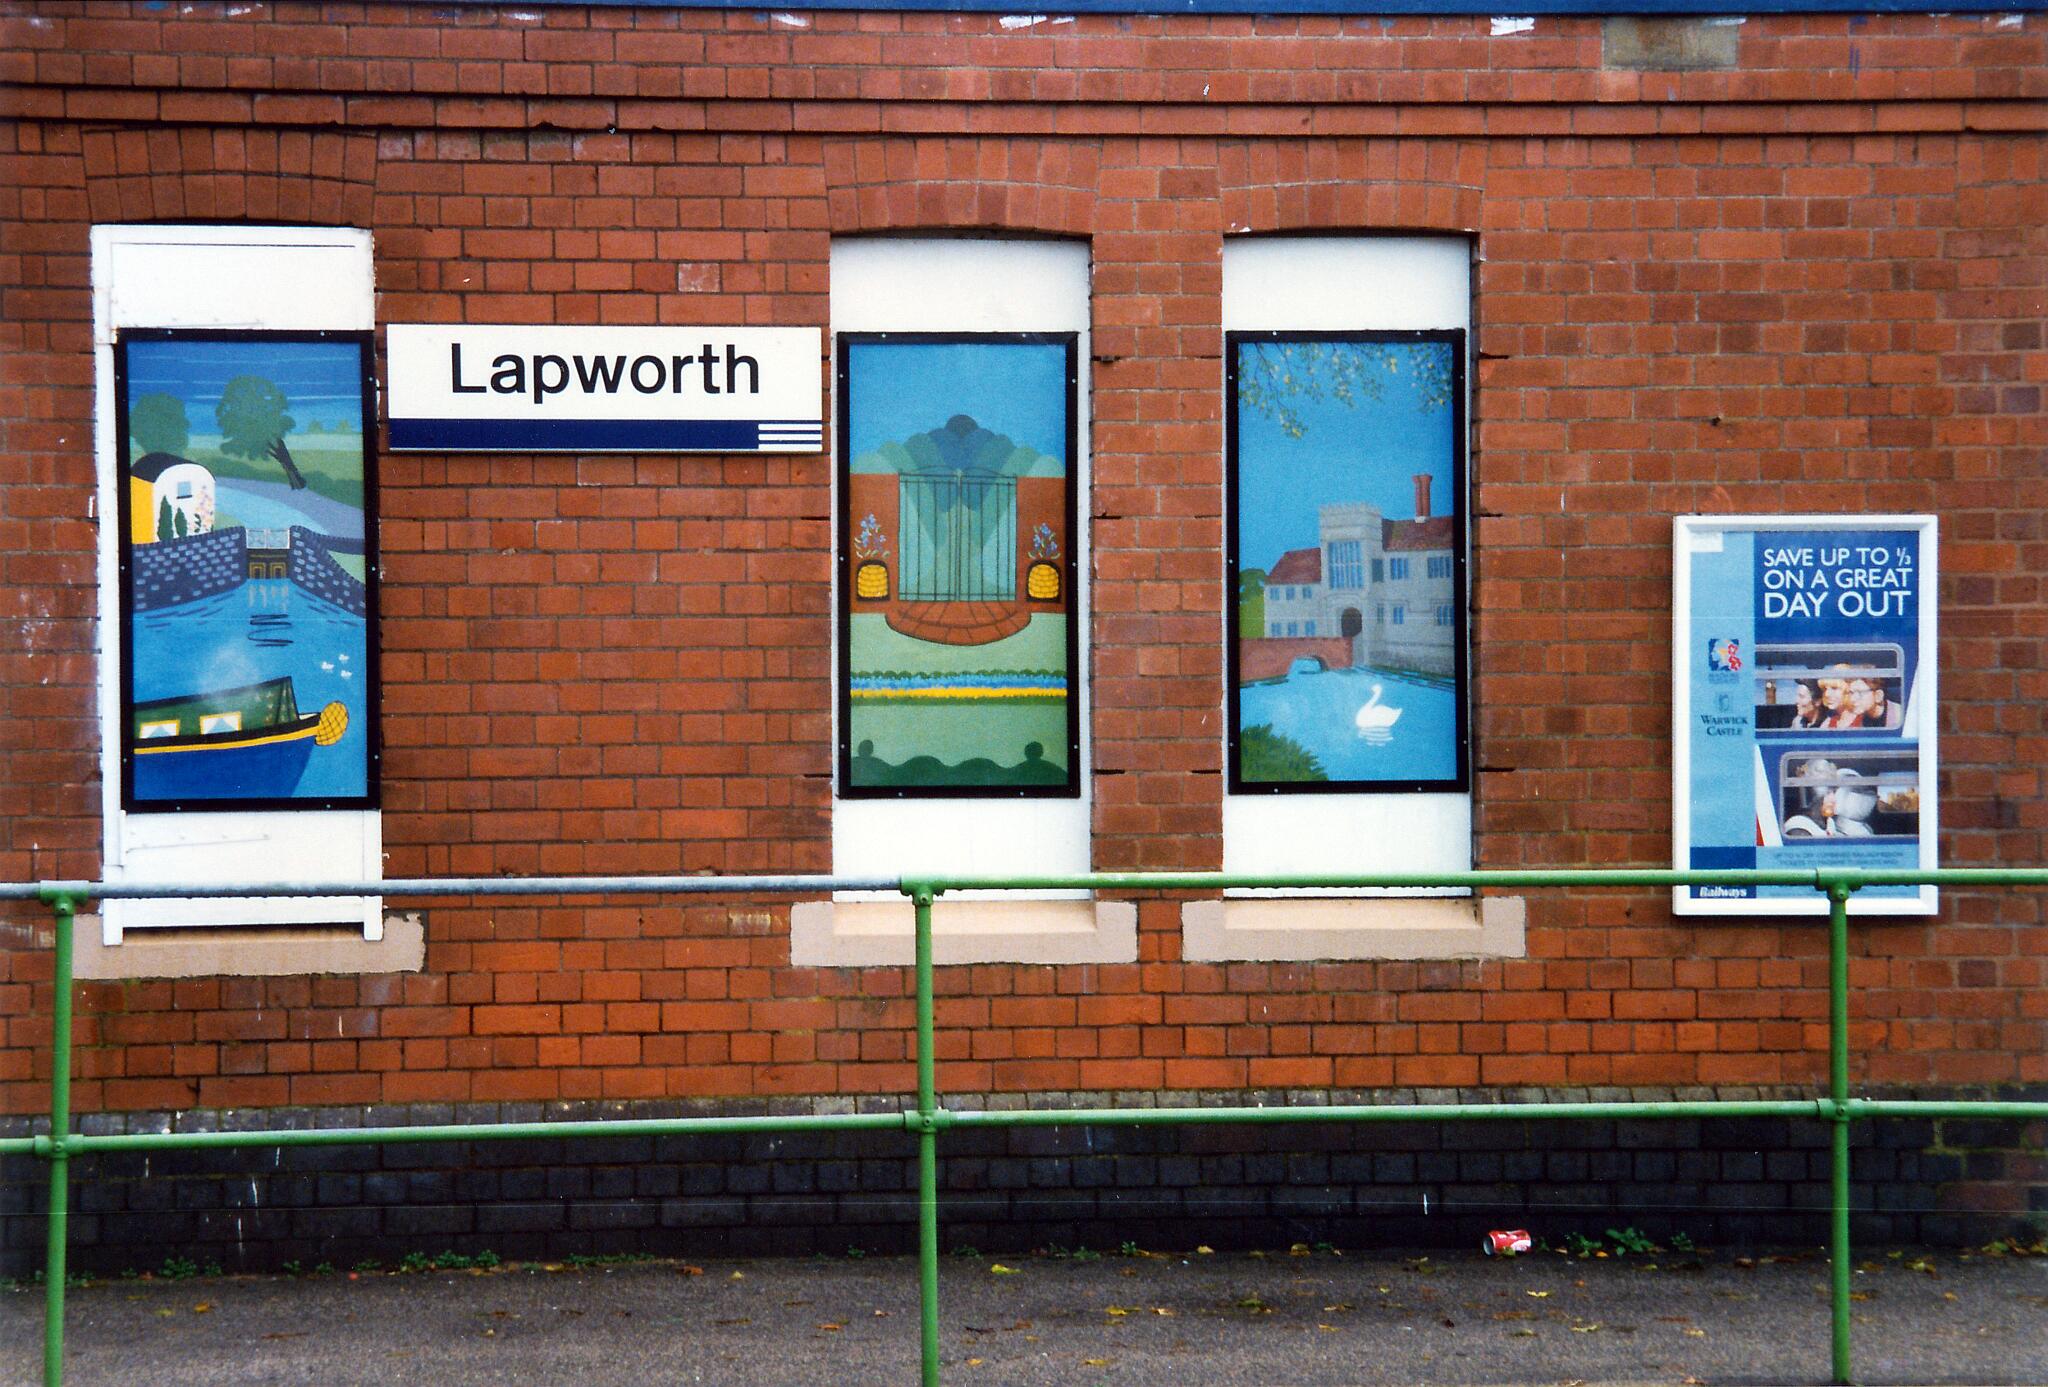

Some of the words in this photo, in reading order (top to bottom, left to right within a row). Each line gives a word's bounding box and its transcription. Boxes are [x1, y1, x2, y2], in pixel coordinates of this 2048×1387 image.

[451, 342, 759, 404] Lapworth
[1763, 548, 1814, 567] SAVE
[1820, 548, 1850, 567] UP
[1856, 547, 1889, 566] TO
[1763, 569, 1804, 590] ON
[1810, 568, 1829, 589] A
[1835, 567, 1913, 589] GREAT
[1764, 591, 1829, 618] DAY
[1837, 590, 1912, 617] OUT
